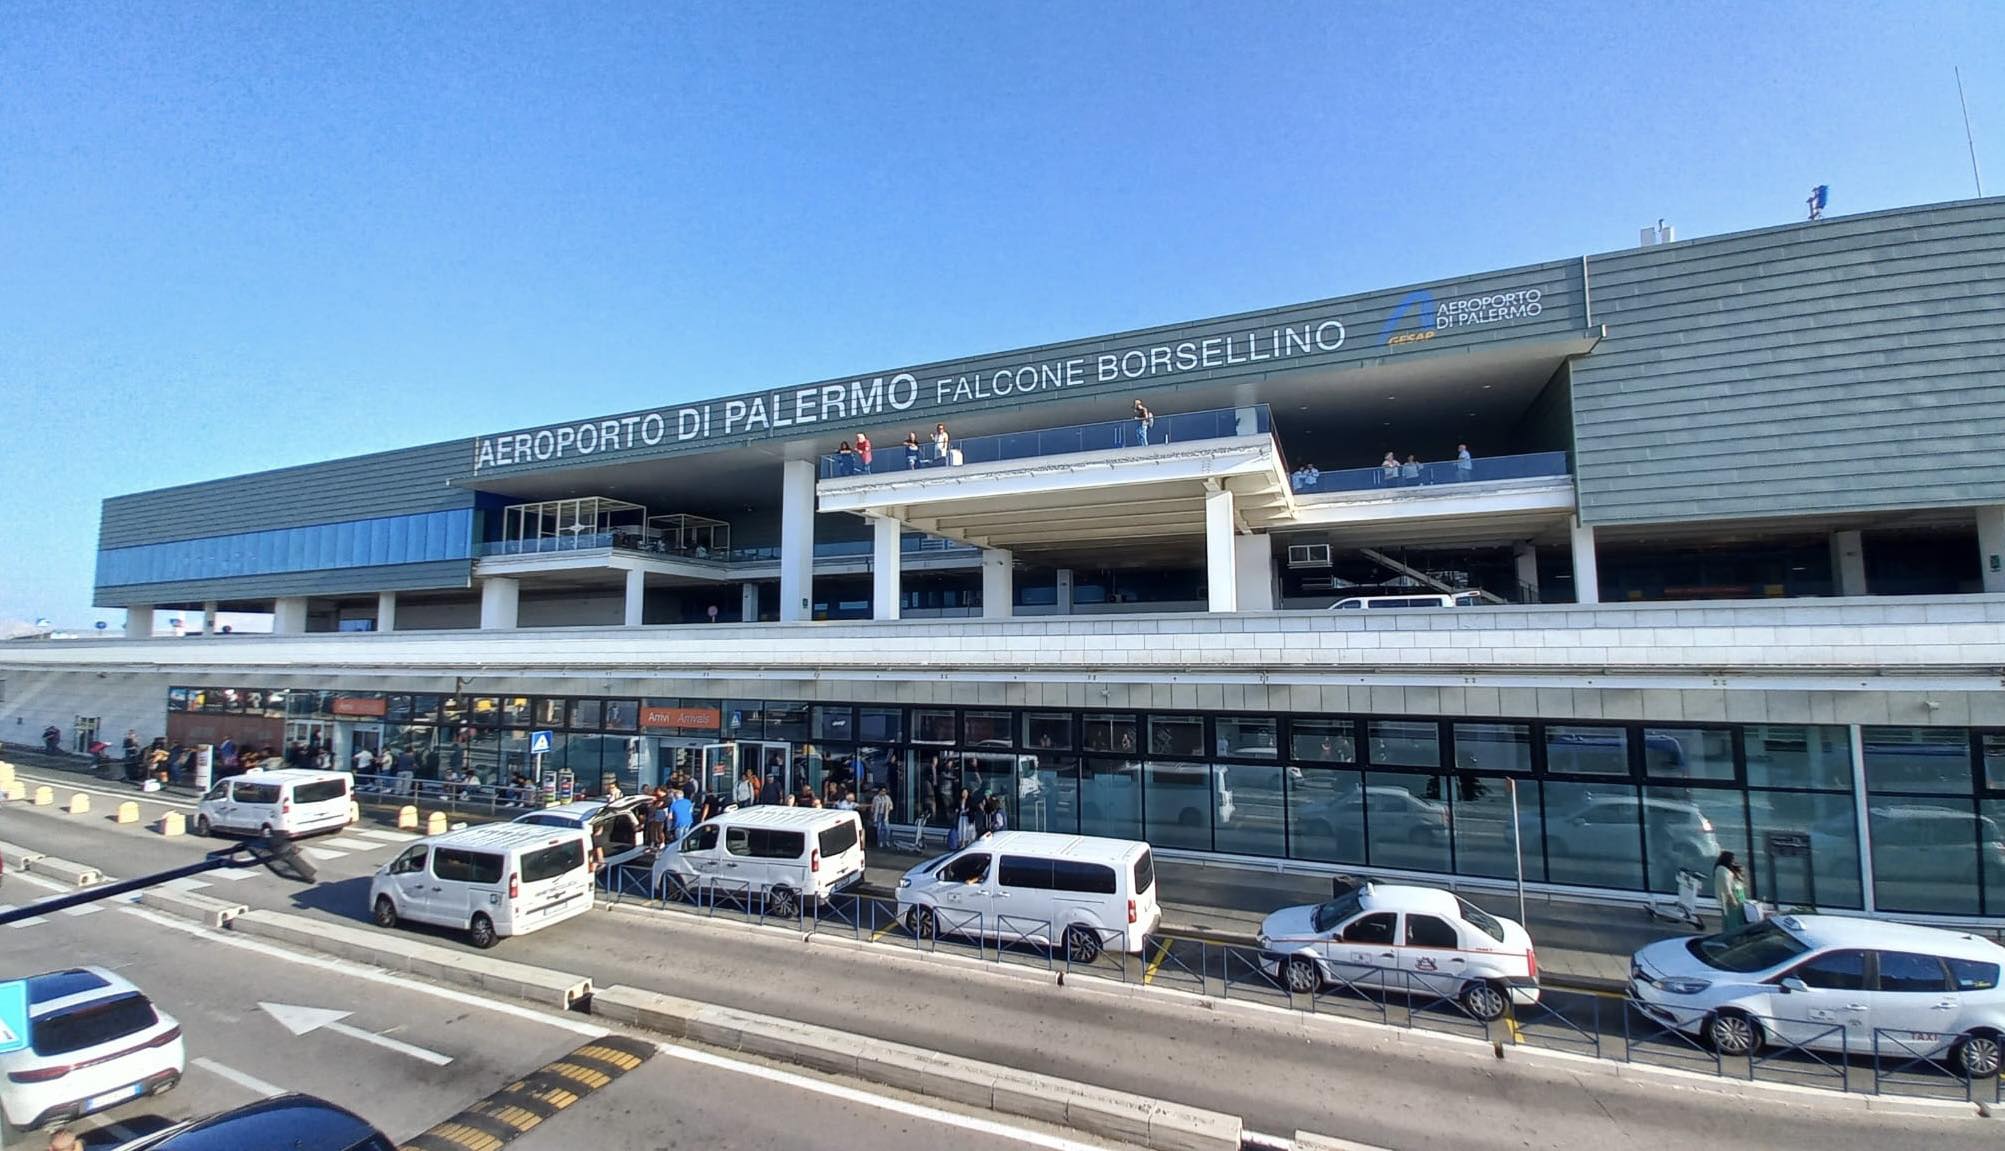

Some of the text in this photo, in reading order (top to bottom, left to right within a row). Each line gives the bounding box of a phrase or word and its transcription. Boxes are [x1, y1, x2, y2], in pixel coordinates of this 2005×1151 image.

[1437, 289, 1541, 316] AEROPORTO
[1436, 303, 1542, 330] DI PALERMO
[1388, 330, 1435, 346] GESAP
[476, 320, 1346, 469] AEROPORTO DI PALERMO FALCONE BORSELLINO
